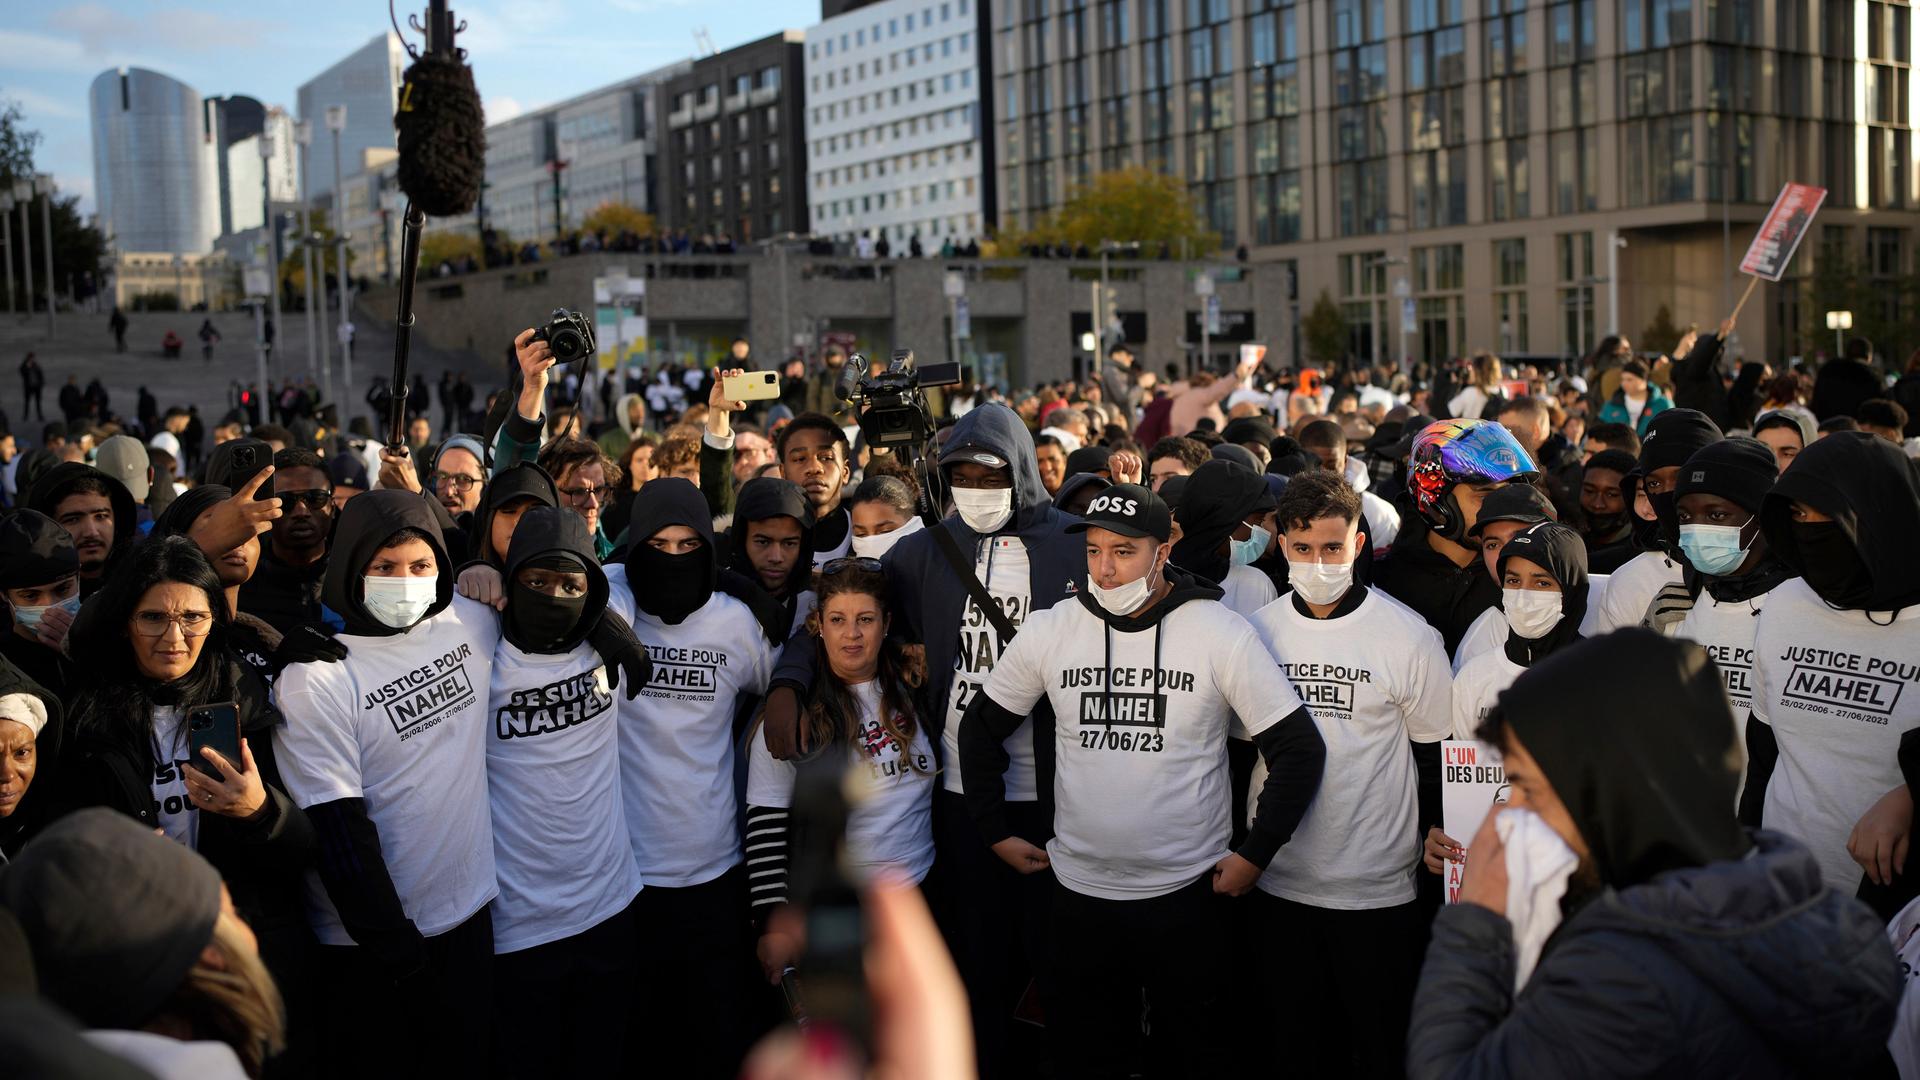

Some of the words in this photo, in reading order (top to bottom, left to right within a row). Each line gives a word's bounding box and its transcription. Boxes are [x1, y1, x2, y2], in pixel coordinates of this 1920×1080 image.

[692, 649, 727, 667] POUR
[1780, 646, 1861, 671] JUSTICE
[365, 665, 436, 710] JUSTICE
[432, 643, 472, 673] POUR
[649, 667, 710, 687] AHEL
[1060, 667, 1137, 689] JUSTCE
[1140, 668, 1195, 692] POUR
[1323, 664, 1371, 683] POUR
[394, 676, 466, 723] NAHEL
[511, 688, 541, 707] JE
[543, 672, 599, 706] SUIS
[1793, 672, 1885, 706] NAHEL
[497, 685, 612, 739] NAHEL
[1780, 698, 1828, 714] 25/02/2006
[1836, 709, 1889, 726] 27/06/2023
[400, 716, 442, 742] 25/02/2006
[1079, 730, 1164, 752] 27/06/23
[1445, 747, 1476, 765] L'UN
[1446, 766, 1472, 783] DES
